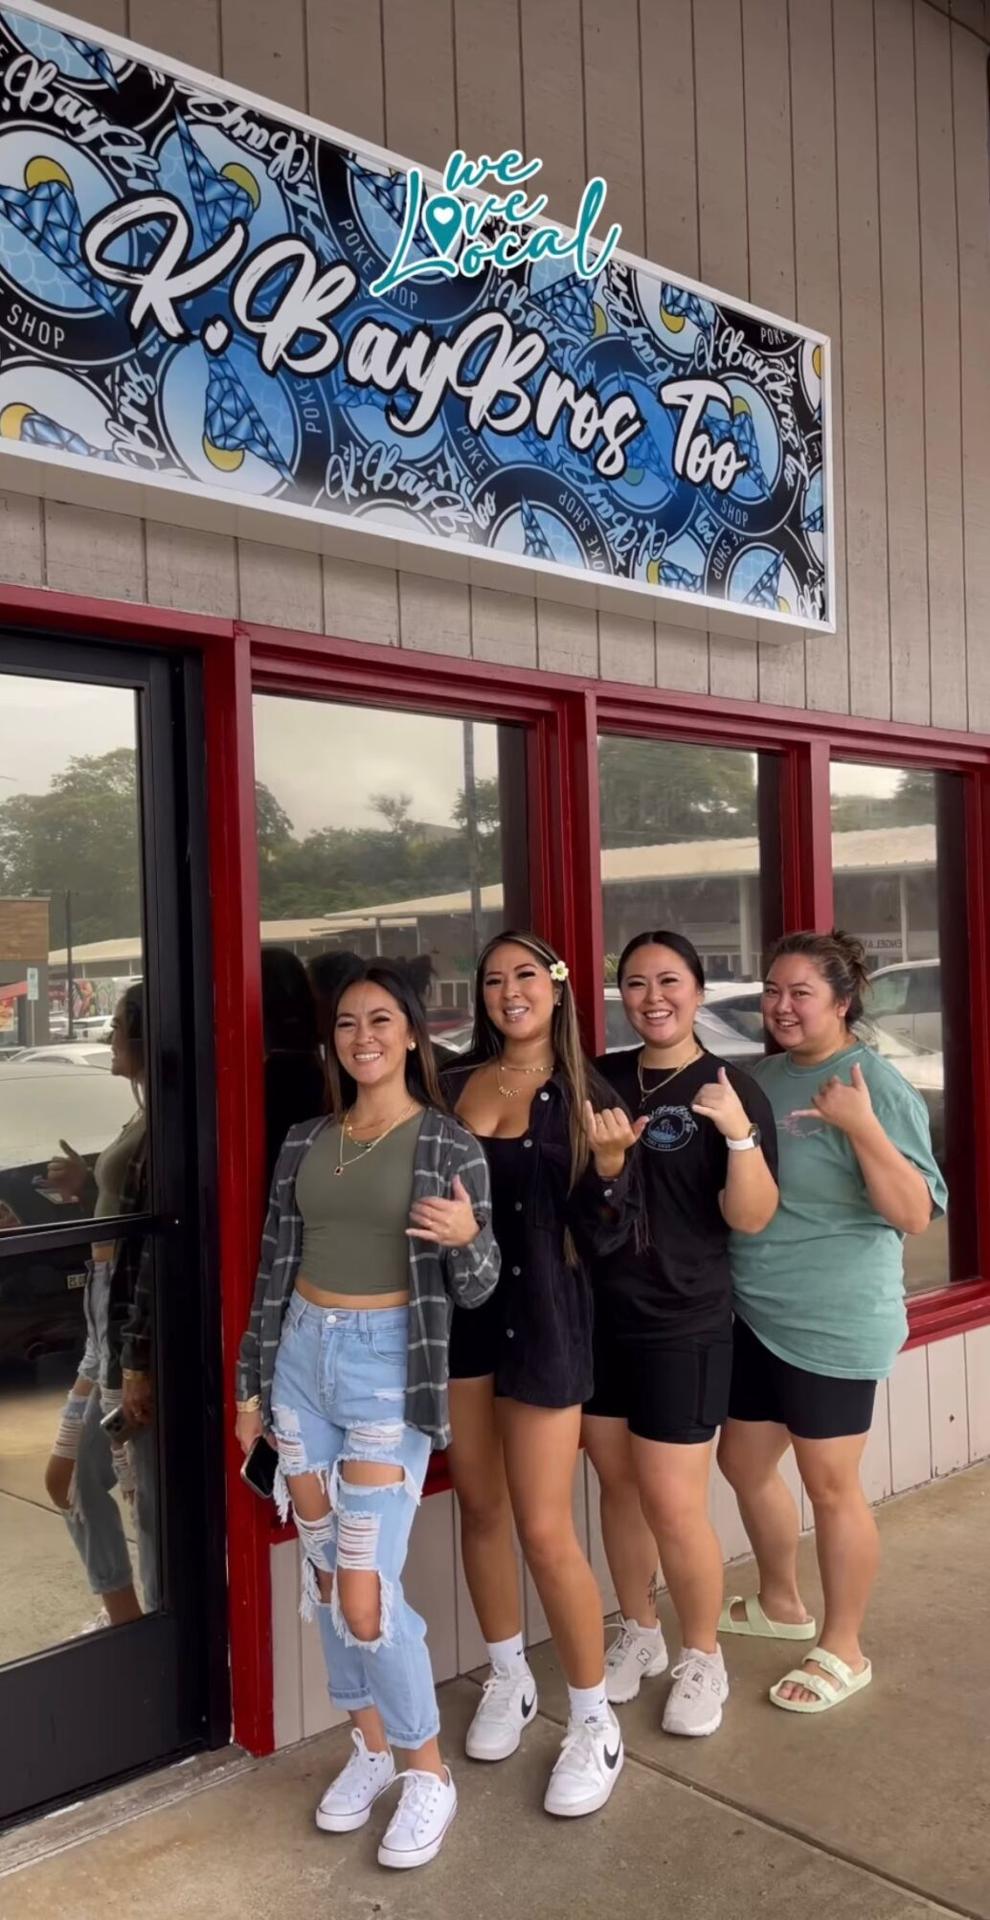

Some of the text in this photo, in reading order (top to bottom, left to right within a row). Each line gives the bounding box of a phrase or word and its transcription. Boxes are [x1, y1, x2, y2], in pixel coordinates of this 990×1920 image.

[339, 219, 377, 275] POKE
[7, 304, 65, 349] SHOP
[760, 326, 788, 346] POKE
[296, 377, 322, 434] POKE
[457, 426, 489, 476] POKE
[661, 379, 747, 490] Too
[558, 491, 606, 570] OKE SHOP
[720, 500, 749, 528] SHOP
